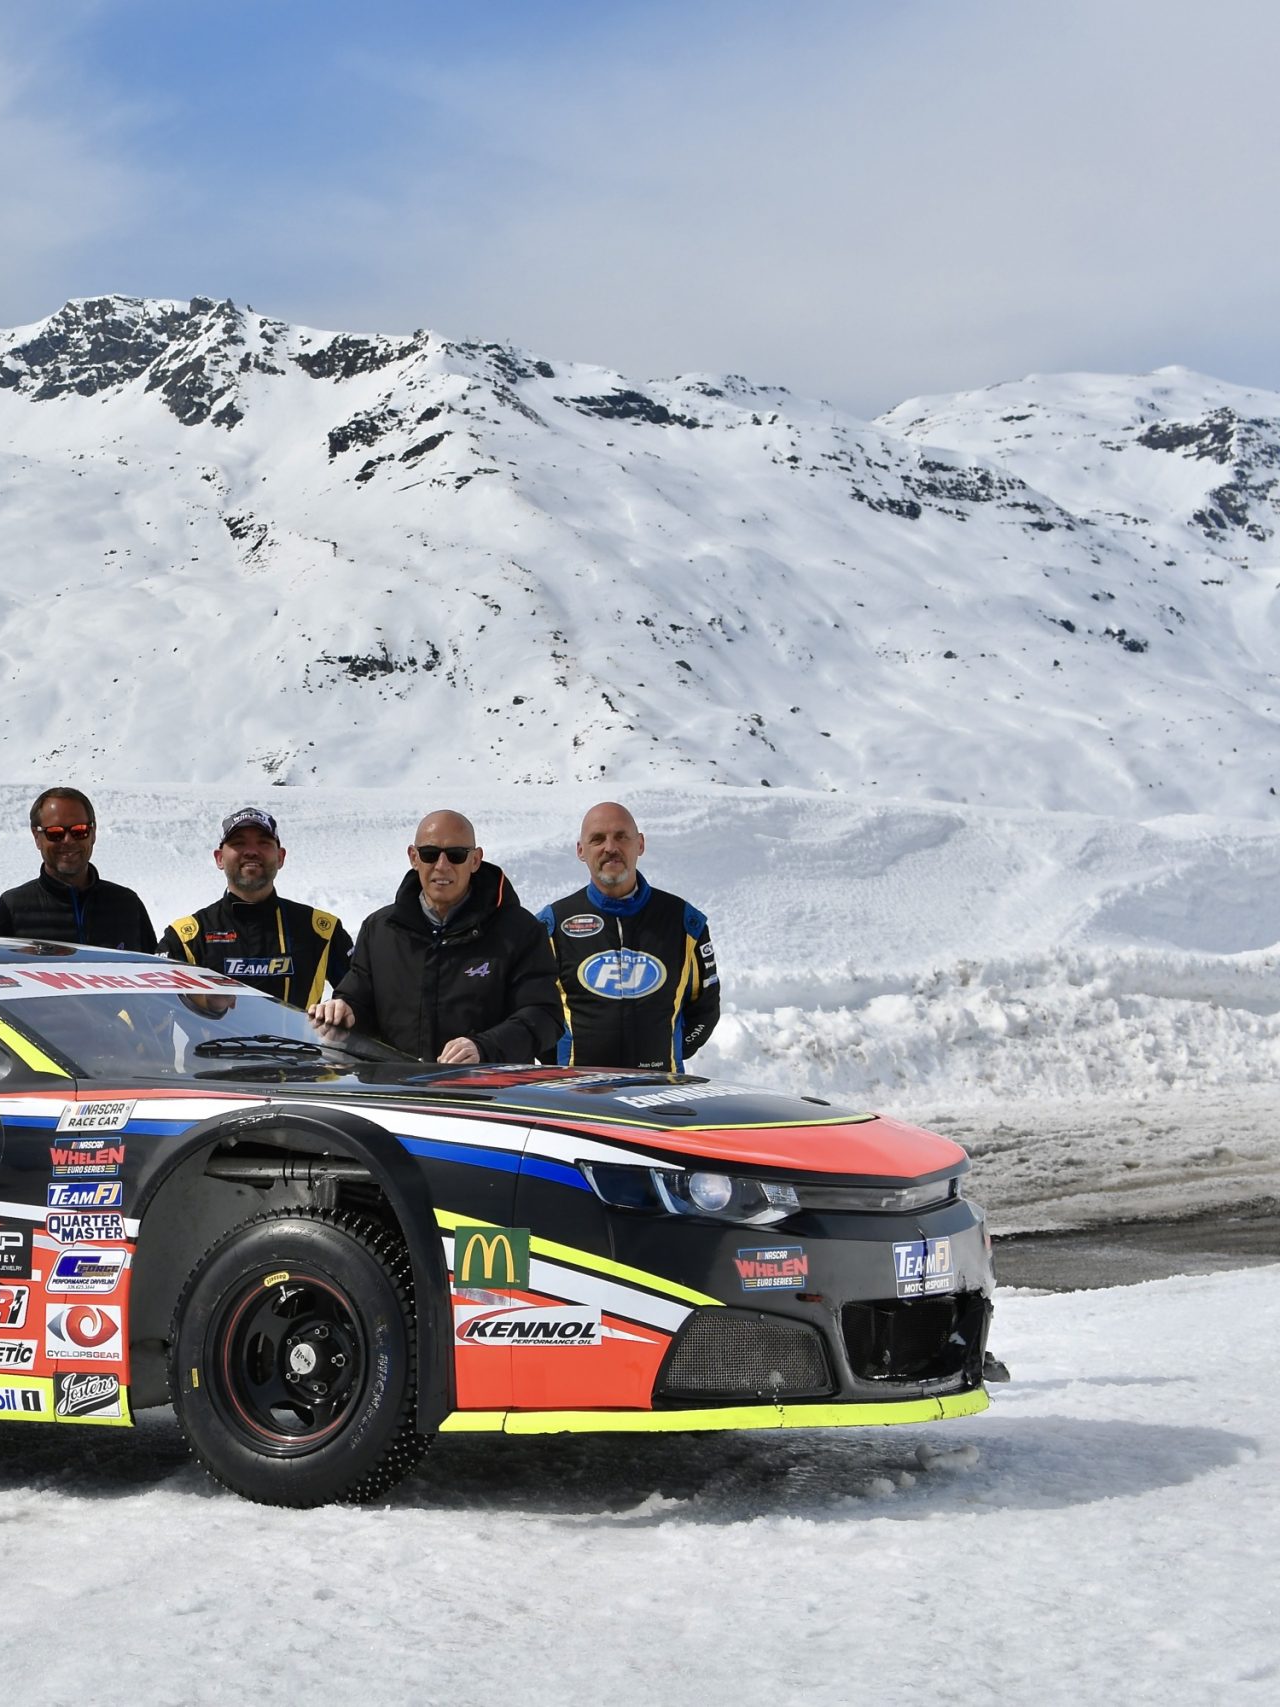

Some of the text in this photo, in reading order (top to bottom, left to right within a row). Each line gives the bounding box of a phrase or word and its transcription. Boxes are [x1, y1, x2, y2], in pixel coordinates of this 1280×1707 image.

[603, 955, 647, 963] TEAM
[16, 969, 215, 990] WHELEN
[594, 963, 647, 988] FJ
[84, 1103, 125, 1116] NASCAR
[68, 1117, 118, 1127] RACE CAR
[79, 1141, 104, 1149] NASCAR
[50, 1145, 126, 1165] WHELEN
[67, 1165, 105, 1174] EURO SERIES
[49, 1215, 120, 1233] QUARTER
[62, 1227, 123, 1242] MASTER
[764, 1251, 787, 1260] NASCAR
[735, 1255, 808, 1278] WHELEN
[757, 1277, 792, 1287] EURO SERIES
[466, 1321, 596, 1339] KENNOL
[47, 1350, 119, 1359] CYCLOPSGEAR
[57, 1374, 119, 1415] Jostens
